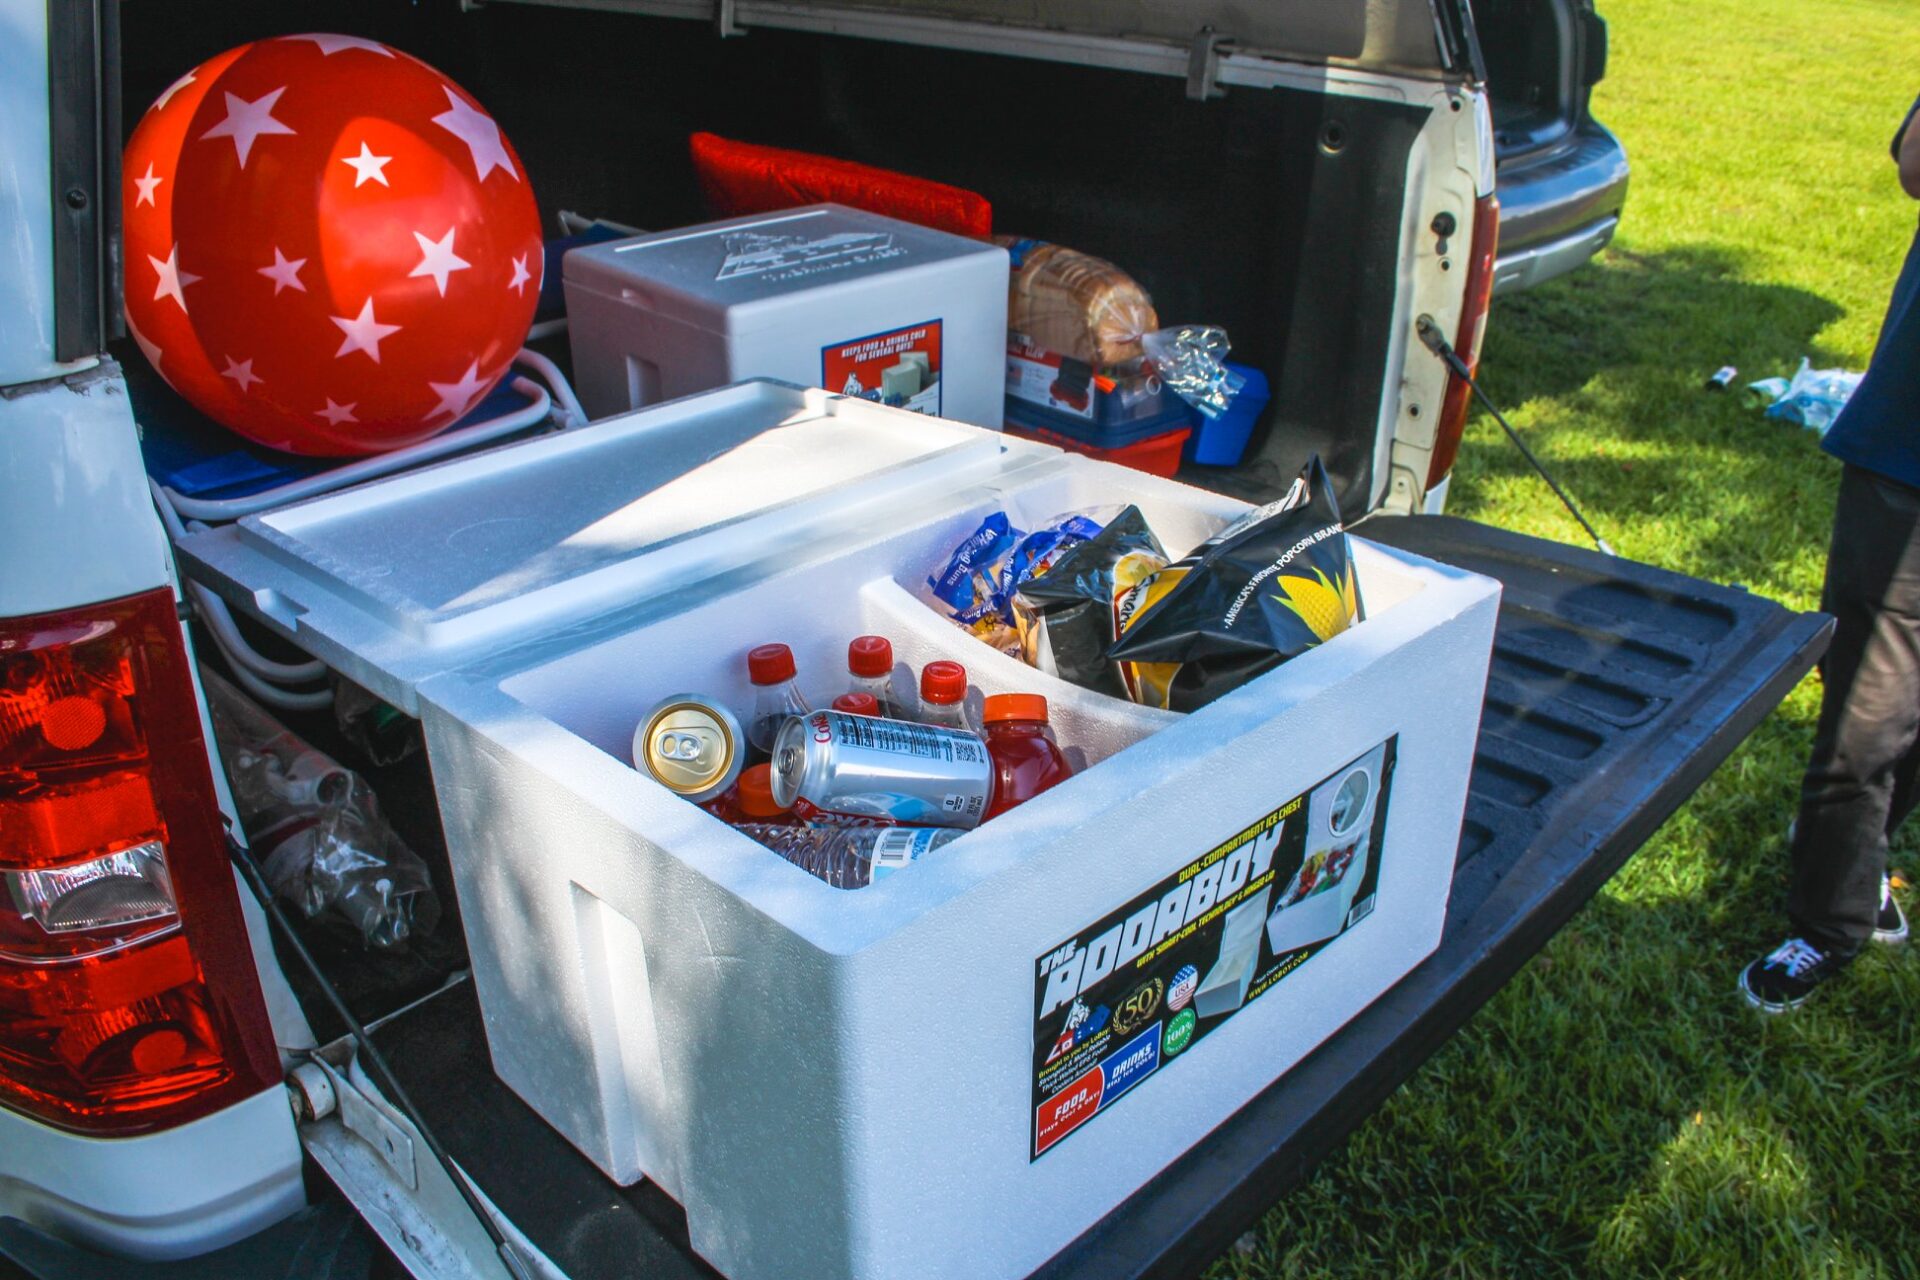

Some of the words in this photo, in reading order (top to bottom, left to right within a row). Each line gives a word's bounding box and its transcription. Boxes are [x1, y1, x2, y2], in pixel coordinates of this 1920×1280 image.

[841, 346, 861, 358] KEEPS
[862, 341, 879, 352] FOOD
[855, 352, 868, 363] FOR
[868, 346, 894, 360] SEVERAL
[1276, 536, 1316, 567] POPCORN
[947, 563, 967, 586] Buns
[1179, 820, 1265, 884] DUAL-COMPARTMENT
[1266, 812, 1278, 828] ICE
[1278, 797, 1302, 820] CHEST
[1040, 939, 1077, 977] THE
[1174, 983, 1190, 998] USA
[1248, 951, 1308, 1000] WWW.LOBOY.COM
[1123, 987, 1153, 1025] 50
[1167, 1021, 1193, 1045] 100%
[1038, 1059, 1063, 1080] Brought
[1112, 1042, 1152, 1079] DRINKS
[1054, 1088, 1087, 1120] FOOD
